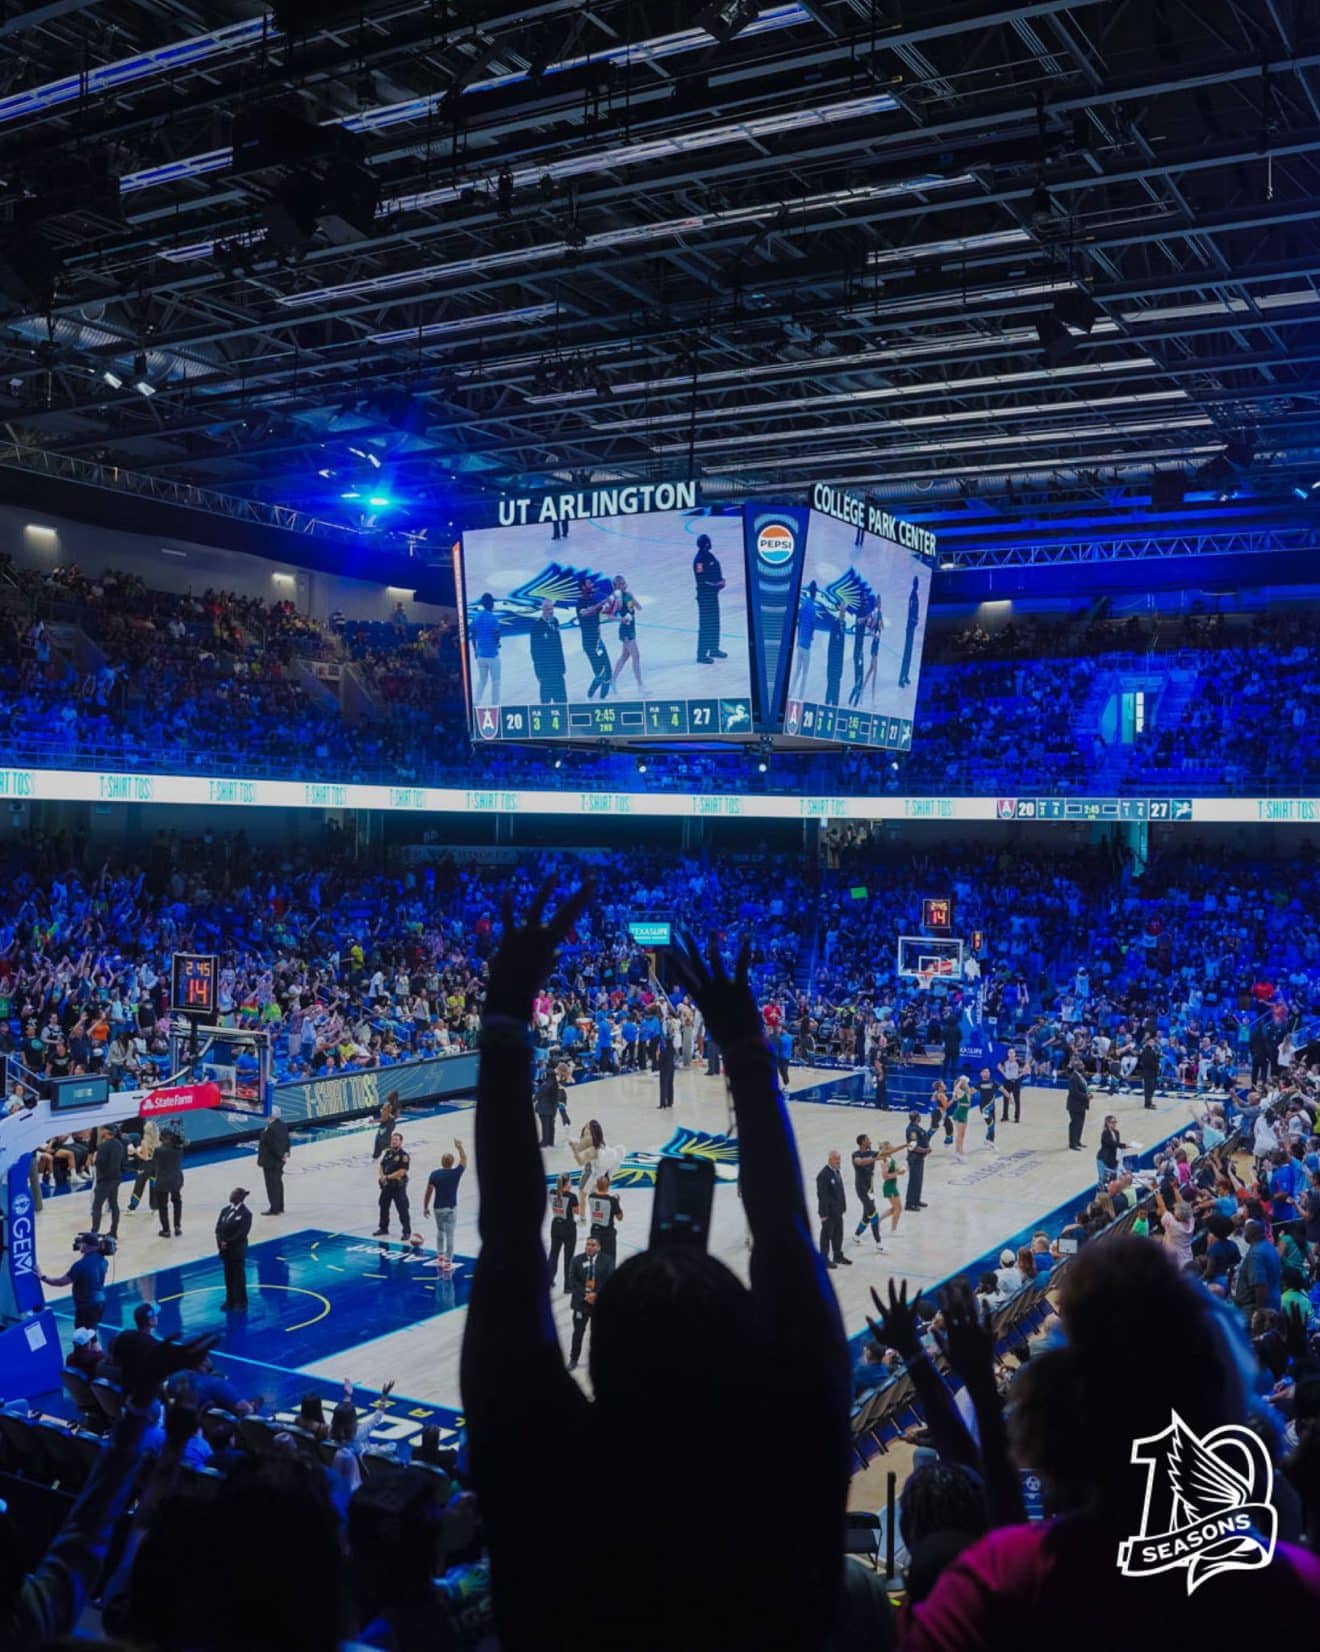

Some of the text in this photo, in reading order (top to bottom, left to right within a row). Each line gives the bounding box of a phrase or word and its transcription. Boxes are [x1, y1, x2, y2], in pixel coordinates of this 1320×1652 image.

[499, 481, 696, 526] UT ARLINGTON
[814, 483, 937, 557] COLLEGE PARK CENTER
[760, 539, 792, 549] PEPSI
[506, 713, 523, 730] 20
[595, 709, 616, 723] 2:45
[652, 713, 658, 727] 1
[693, 708, 711, 725] 27
[533, 717, 541, 731] 3
[1018, 803, 1035, 817] 20
[1151, 803, 1168, 817] 27
[932, 911, 946, 924] 14
[189, 979, 208, 1005] 14
[13, 1216, 32, 1276] GEM
